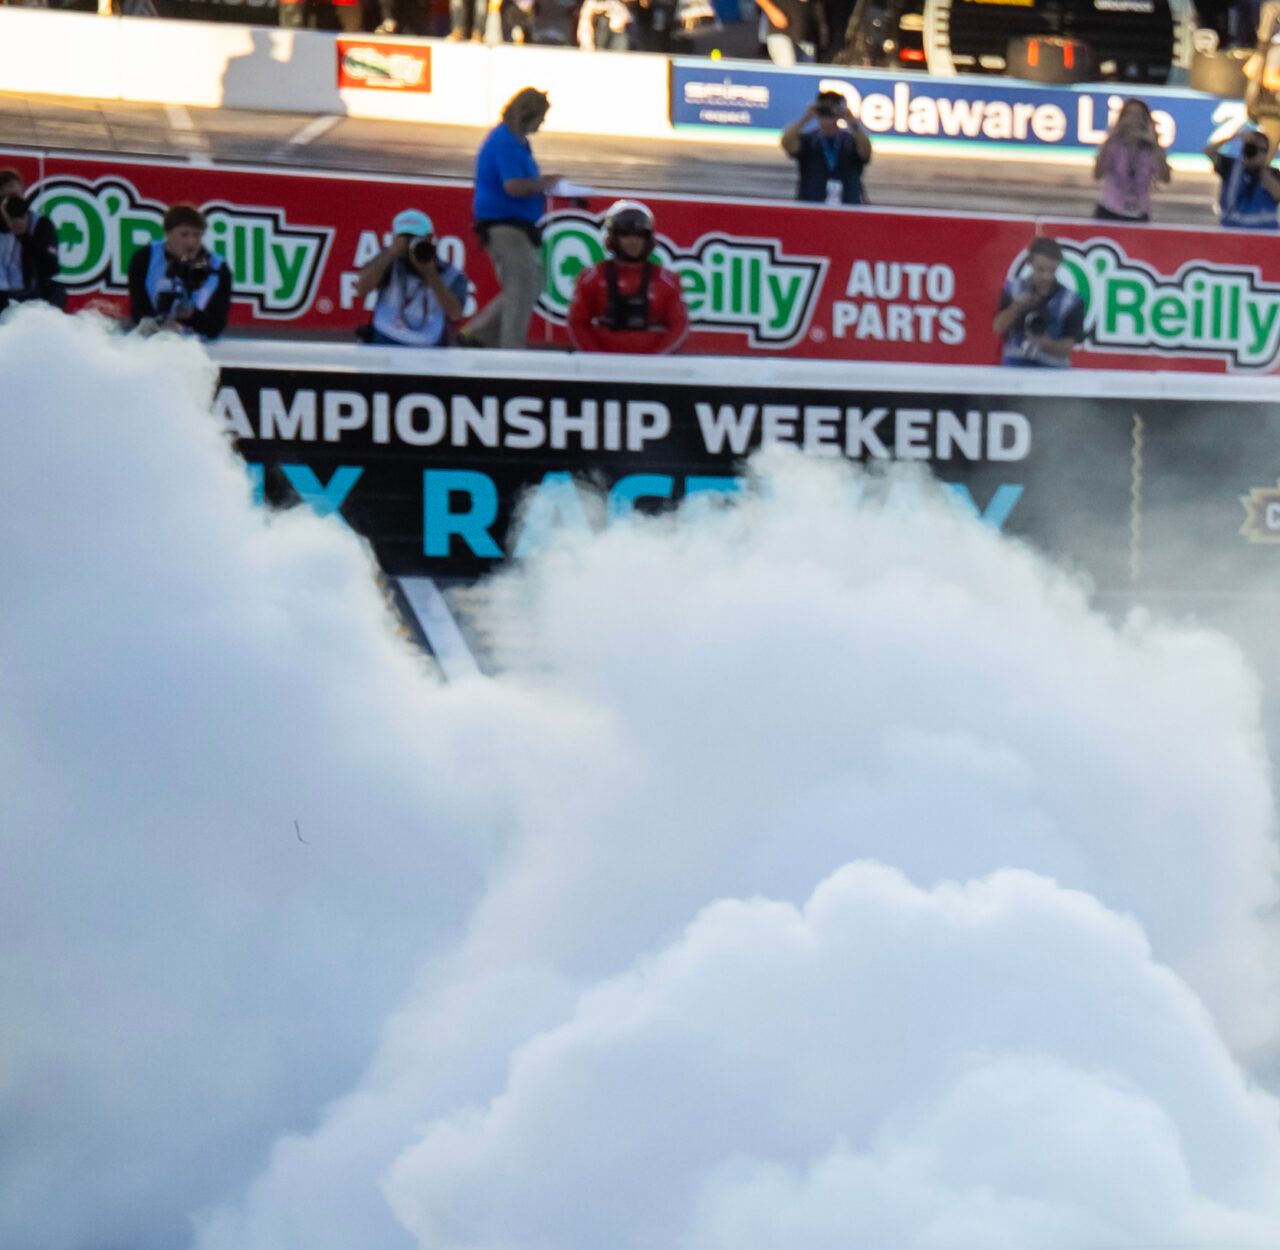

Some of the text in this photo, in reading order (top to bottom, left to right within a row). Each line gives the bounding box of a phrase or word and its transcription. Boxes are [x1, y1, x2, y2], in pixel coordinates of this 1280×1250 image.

[42, 194, 307, 299] O'Rilly
[541, 228, 802, 329] Oeilly
[846, 260, 955, 302] AUTO
[832, 302, 966, 344] PARTS
[695, 402, 1032, 462] WEEKEND
